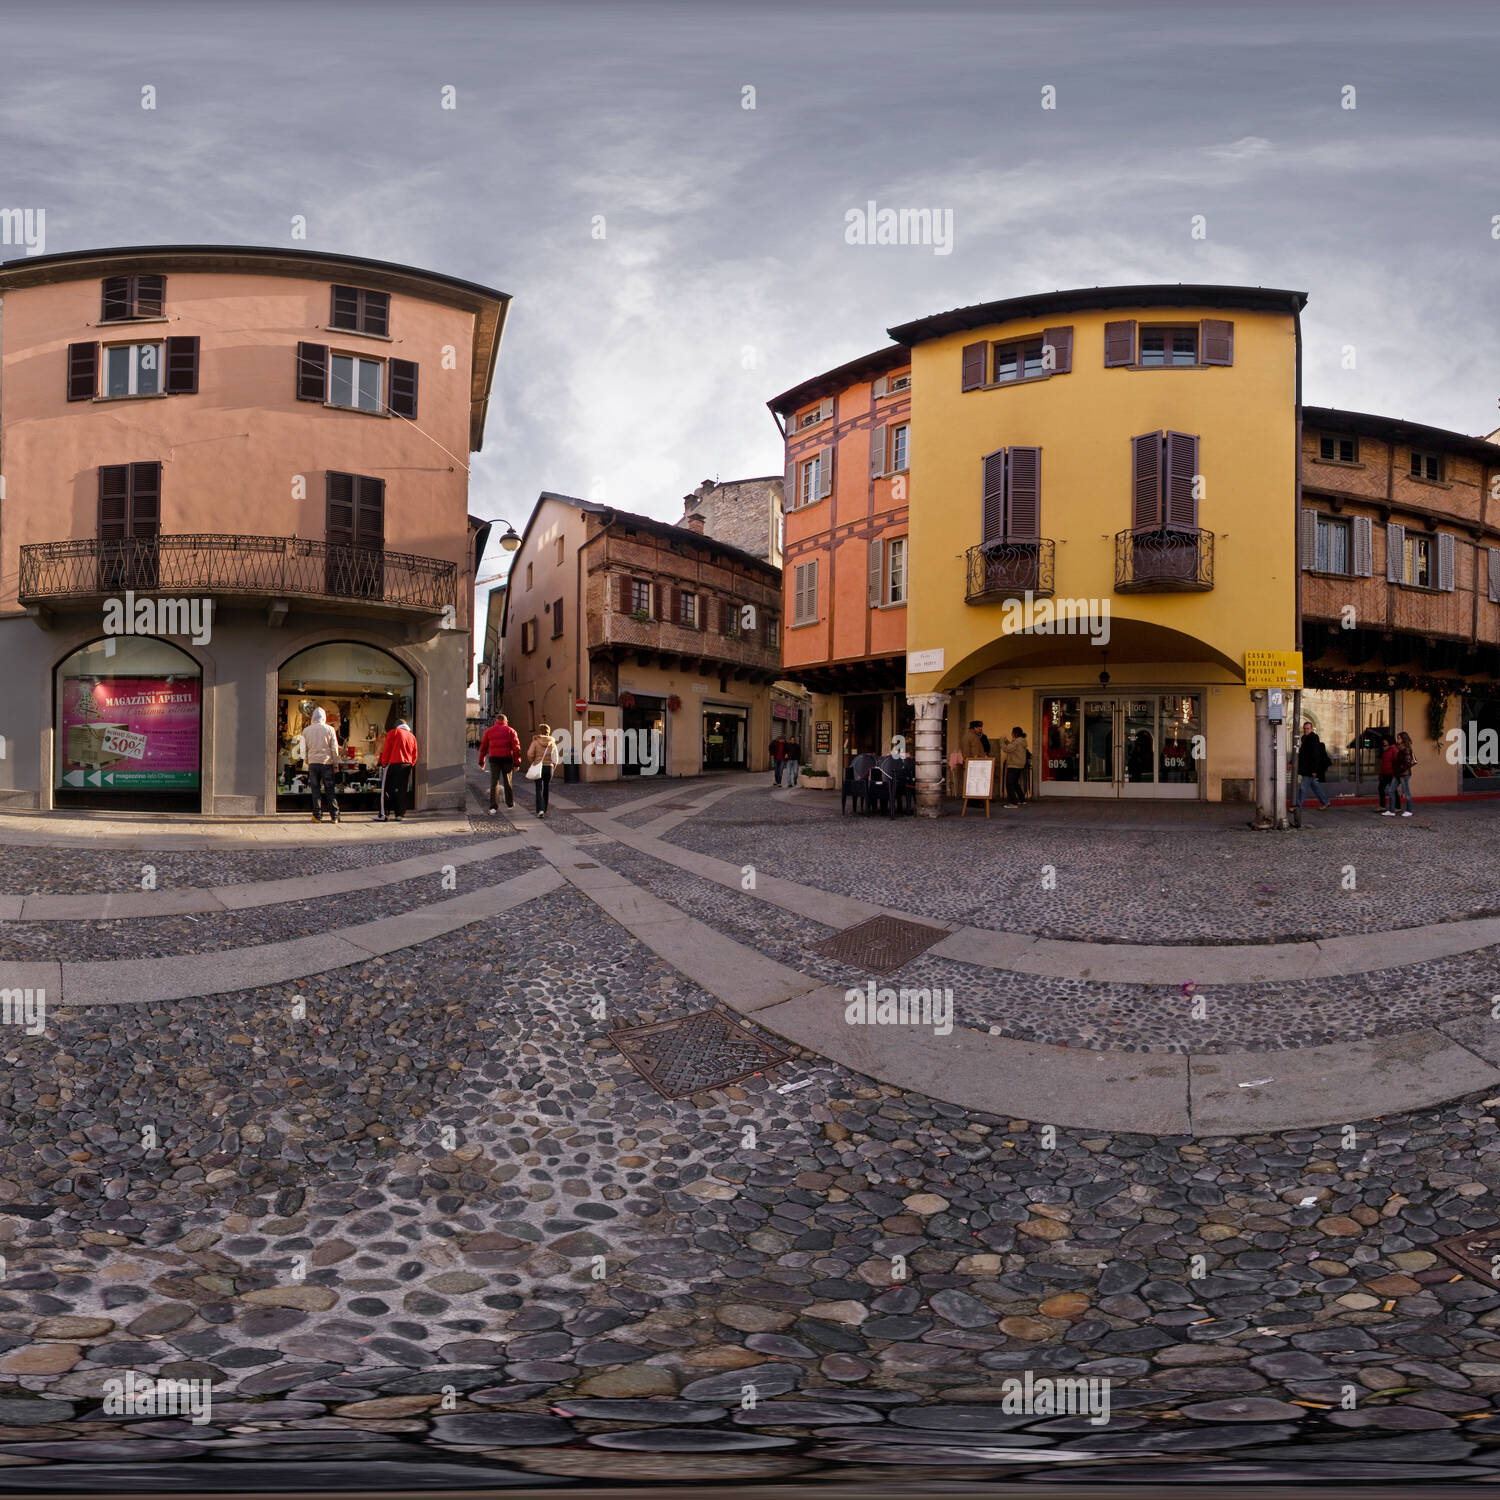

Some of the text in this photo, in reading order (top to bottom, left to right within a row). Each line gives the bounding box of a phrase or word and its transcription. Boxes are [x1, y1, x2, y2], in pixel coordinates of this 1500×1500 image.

[105, 694, 192, 707] MAGAZZINI APERTI
[126, 733, 137, 741] fino
[109, 737, 141, 755] 50%
[1048, 759, 1067, 769] 60%
[1164, 757, 1185, 767] 60%
